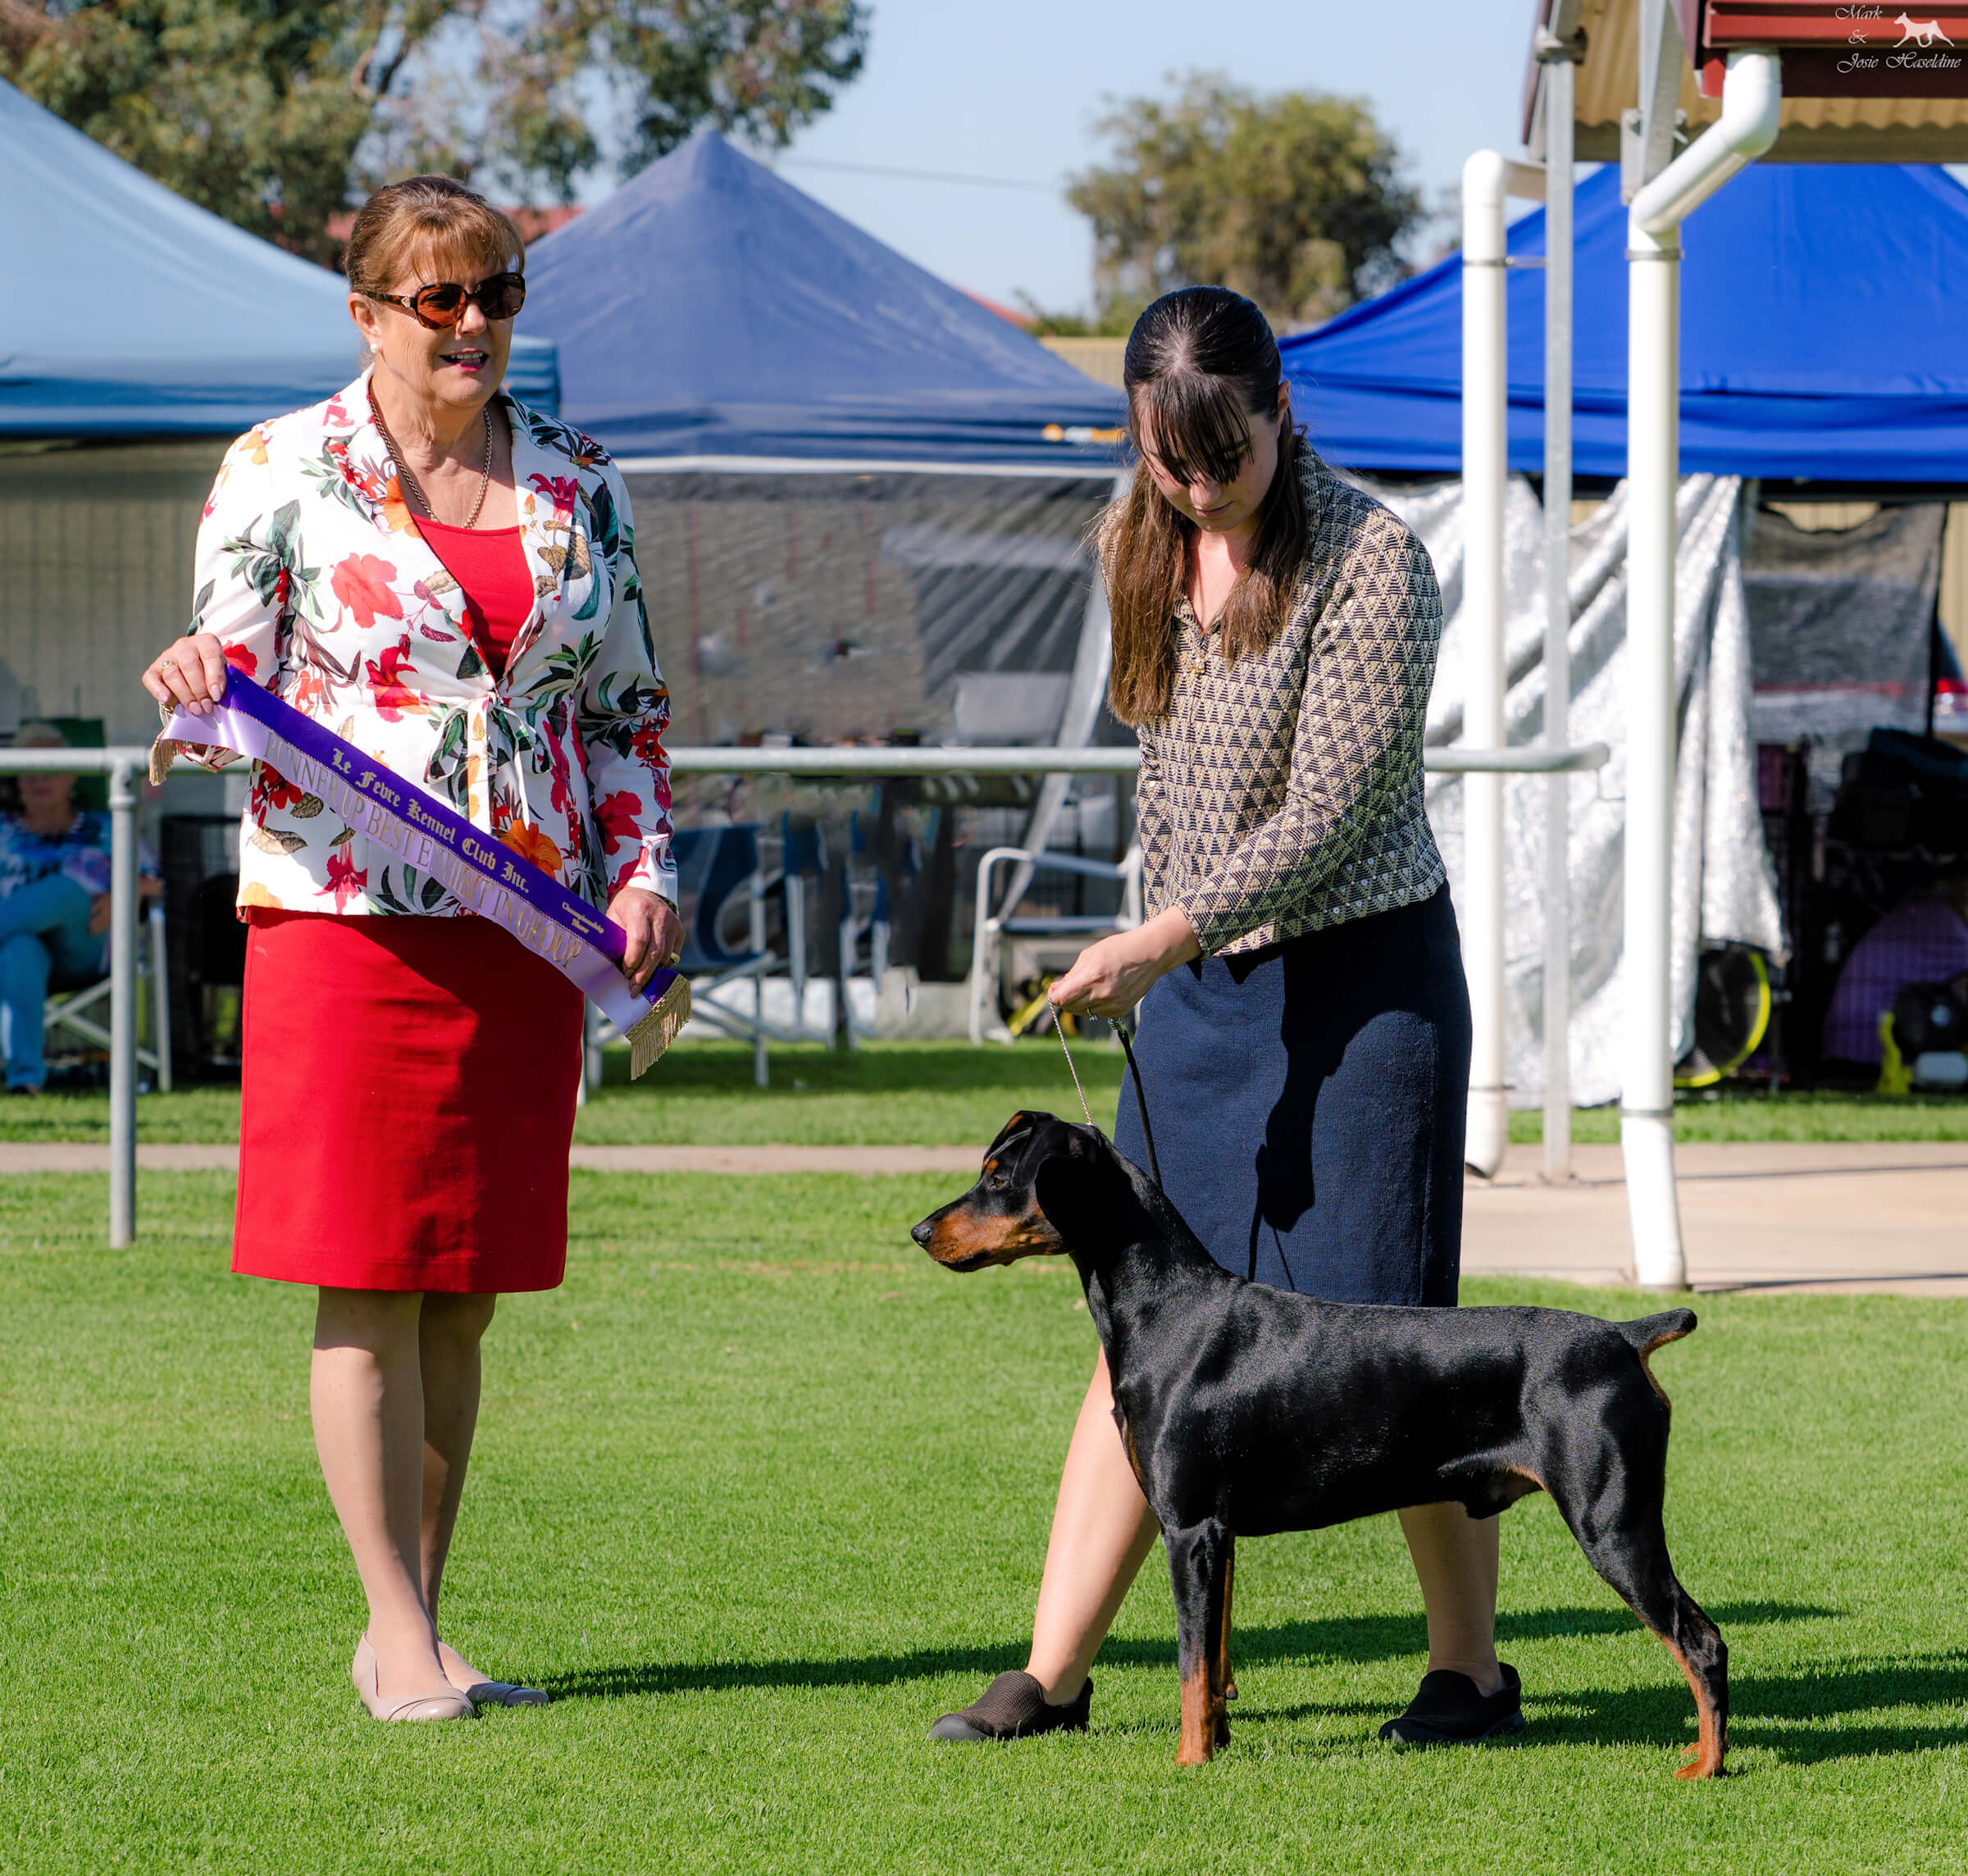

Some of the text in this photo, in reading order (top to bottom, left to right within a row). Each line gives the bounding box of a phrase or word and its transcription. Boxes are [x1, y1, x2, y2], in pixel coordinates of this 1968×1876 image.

[264, 731, 582, 969] RUNNER UP BEST EXHIBIT IN GROUP
[332, 748, 530, 894] Le Fevre Kennel Club Inc.
